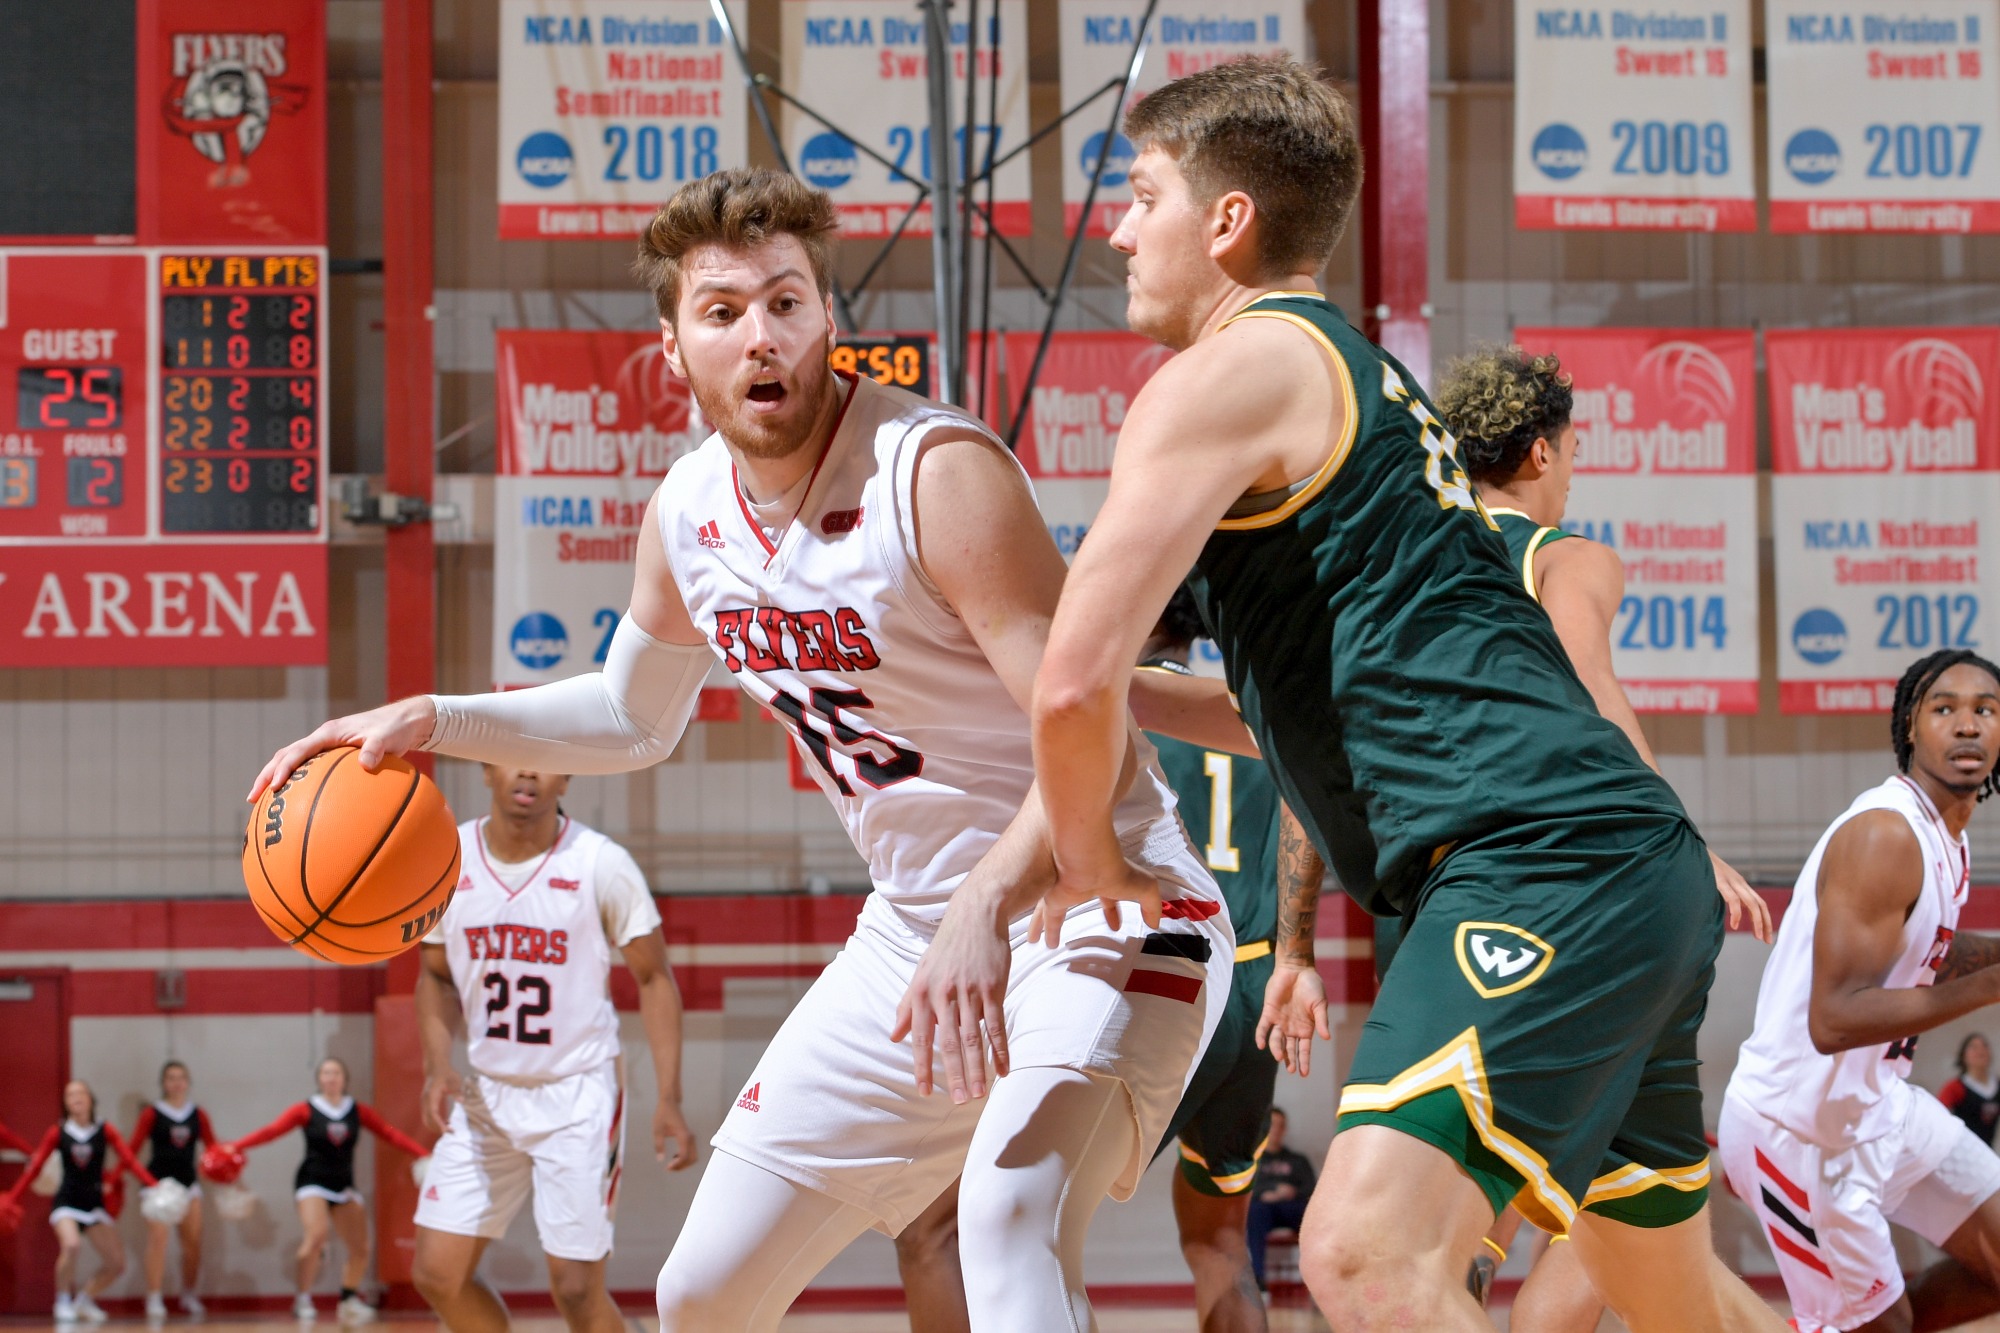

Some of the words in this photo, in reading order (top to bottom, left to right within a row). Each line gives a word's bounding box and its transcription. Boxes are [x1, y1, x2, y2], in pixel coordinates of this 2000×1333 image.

[524, 16, 593, 45] NCAA
[602, 16, 699, 45] Division
[806, 16, 873, 45] NCAA
[1161, 16, 1256, 44] Division
[1536, 10, 1602, 39] NCAA
[1612, 11, 1705, 40] Division
[1787, 16, 1854, 43] NCAA
[1863, 15, 1957, 43] Division
[172, 33, 286, 77] FLYERS
[607, 53, 722, 81] National
[1616, 46, 1694, 77] Sweet
[1867, 50, 1946, 79] Sweet
[556, 87, 722, 118] Semifinalist
[603, 125, 719, 182] 2018
[1612, 120, 1730, 176] 2009
[1864, 123, 1983, 179] 2007
[163, 256, 213, 288] PLY
[223, 256, 259, 288] FL
[264, 256, 317, 288] PTS
[227, 296, 250, 330] 2
[289, 296, 312, 330] 2
[23, 329, 118, 361] GUEST
[178, 337, 213, 367] 11
[227, 334, 250, 369] 0
[289, 334, 312, 369] 8
[40, 368, 118, 428] 25
[165, 376, 213, 412] 20
[227, 376, 250, 412] 2
[289, 378, 312, 410] 4
[523, 383, 619, 426] Men's
[1031, 385, 1127, 428] Men's
[1570, 383, 1634, 424] en's
[1792, 382, 1886, 423] Men's
[63, 432, 128, 457] FOULS
[165, 416, 213, 450] 22
[227, 416, 250, 450] 2
[289, 415, 312, 450] 0
[1572, 420, 1727, 475] olleyball
[1794, 418, 1978, 475] Volleyball
[5, 458, 30, 507] 3
[87, 458, 115, 506] 2
[165, 457, 213, 493] 23
[227, 457, 250, 493] 0
[289, 457, 312, 493] 2
[523, 496, 593, 528] NCAA
[1623, 520, 1726, 549] National
[1804, 519, 1871, 548] NCAA
[1878, 519, 1979, 549] National
[1834, 555, 1979, 585] Semifinalist
[23, 571, 315, 637] ARENA
[1618, 594, 1728, 651] 2014
[1875, 593, 1980, 650] 2012
[714, 606, 881, 674] FLYERS
[769, 686, 924, 797] 15
[1204, 751, 1240, 872] 1
[464, 923, 568, 965] FLYERS
[483, 971, 553, 1046] 22
